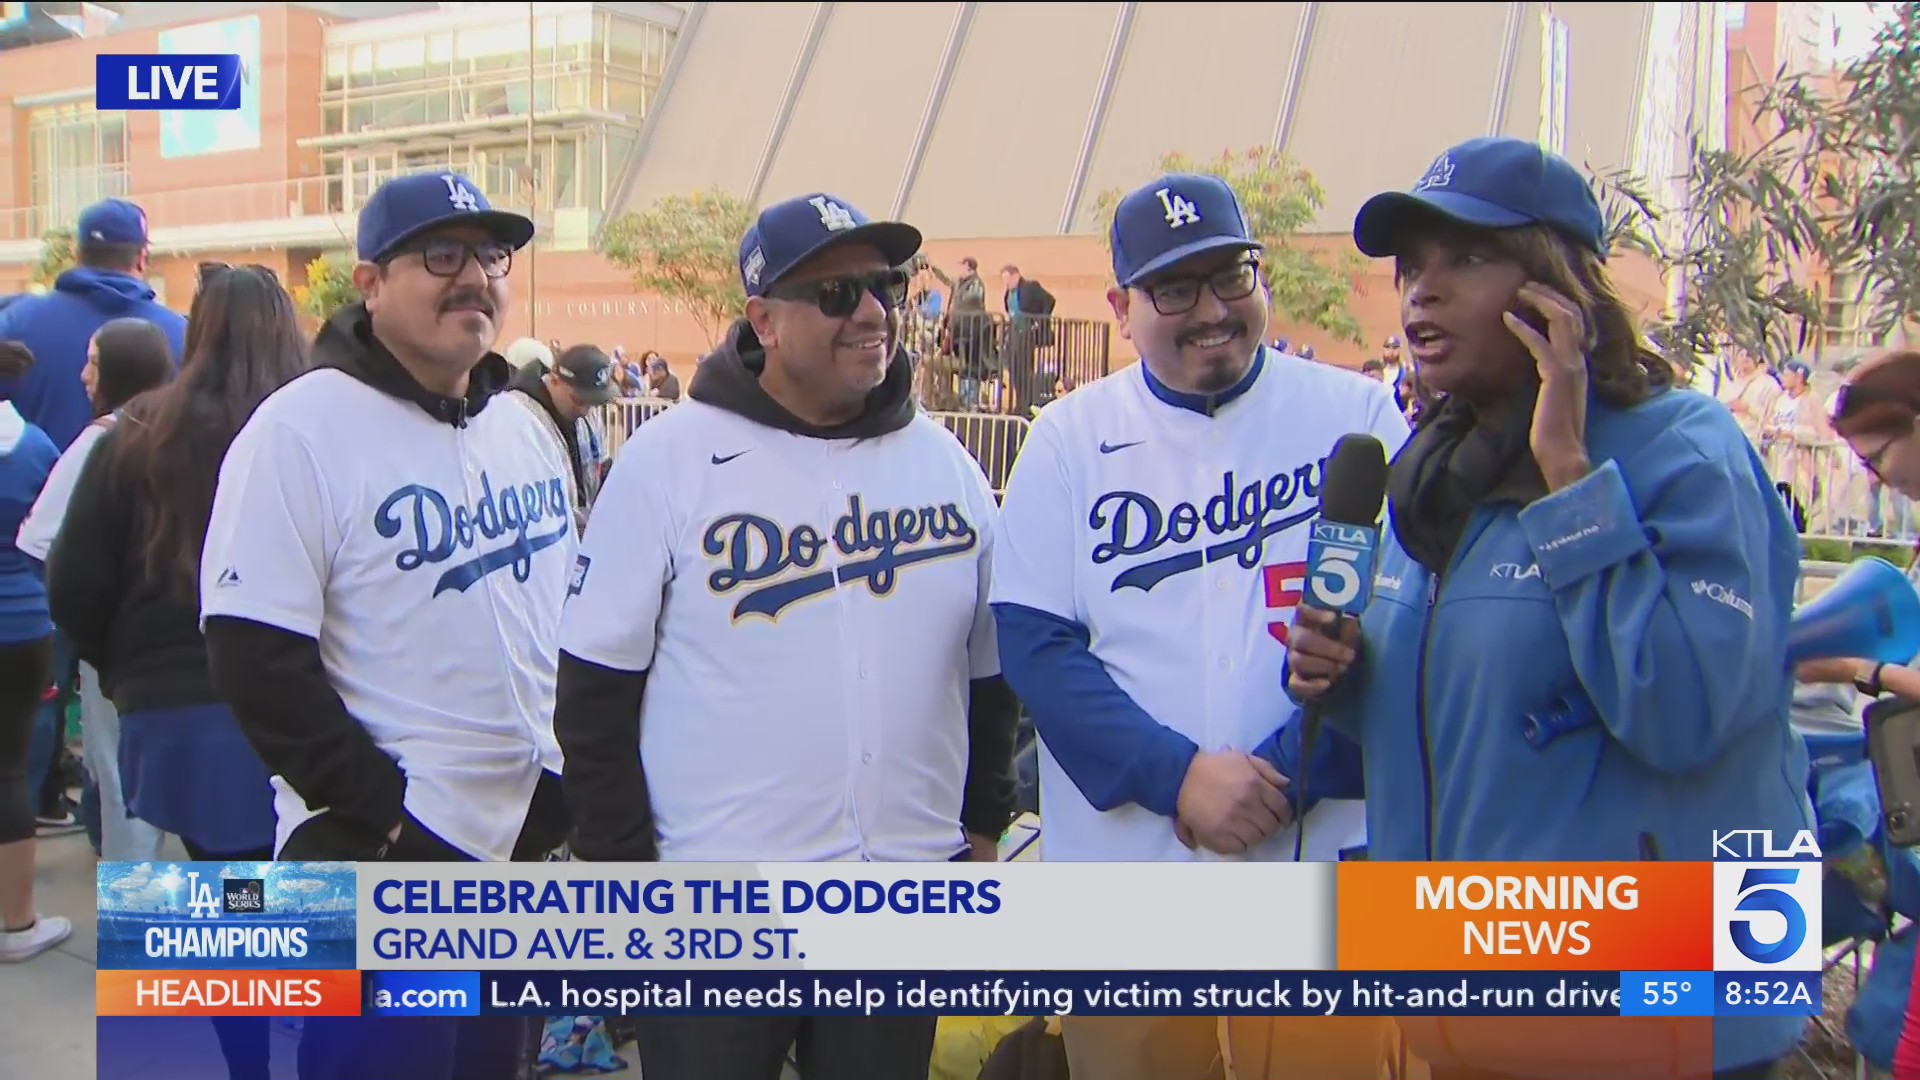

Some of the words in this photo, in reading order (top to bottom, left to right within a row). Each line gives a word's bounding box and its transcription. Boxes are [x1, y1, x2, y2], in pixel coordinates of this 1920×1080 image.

[440, 174, 480, 212] LA
[808, 195, 857, 232] LA
[1155, 187, 1200, 229] LA
[374, 470, 569, 596] Dodgers
[1089, 455, 1324, 572] Dodger
[1314, 523, 1368, 545] KTLA
[702, 491, 979, 606] Dodgers
[1310, 546, 1361, 607] 5
[1489, 562, 1542, 580] KTLA
